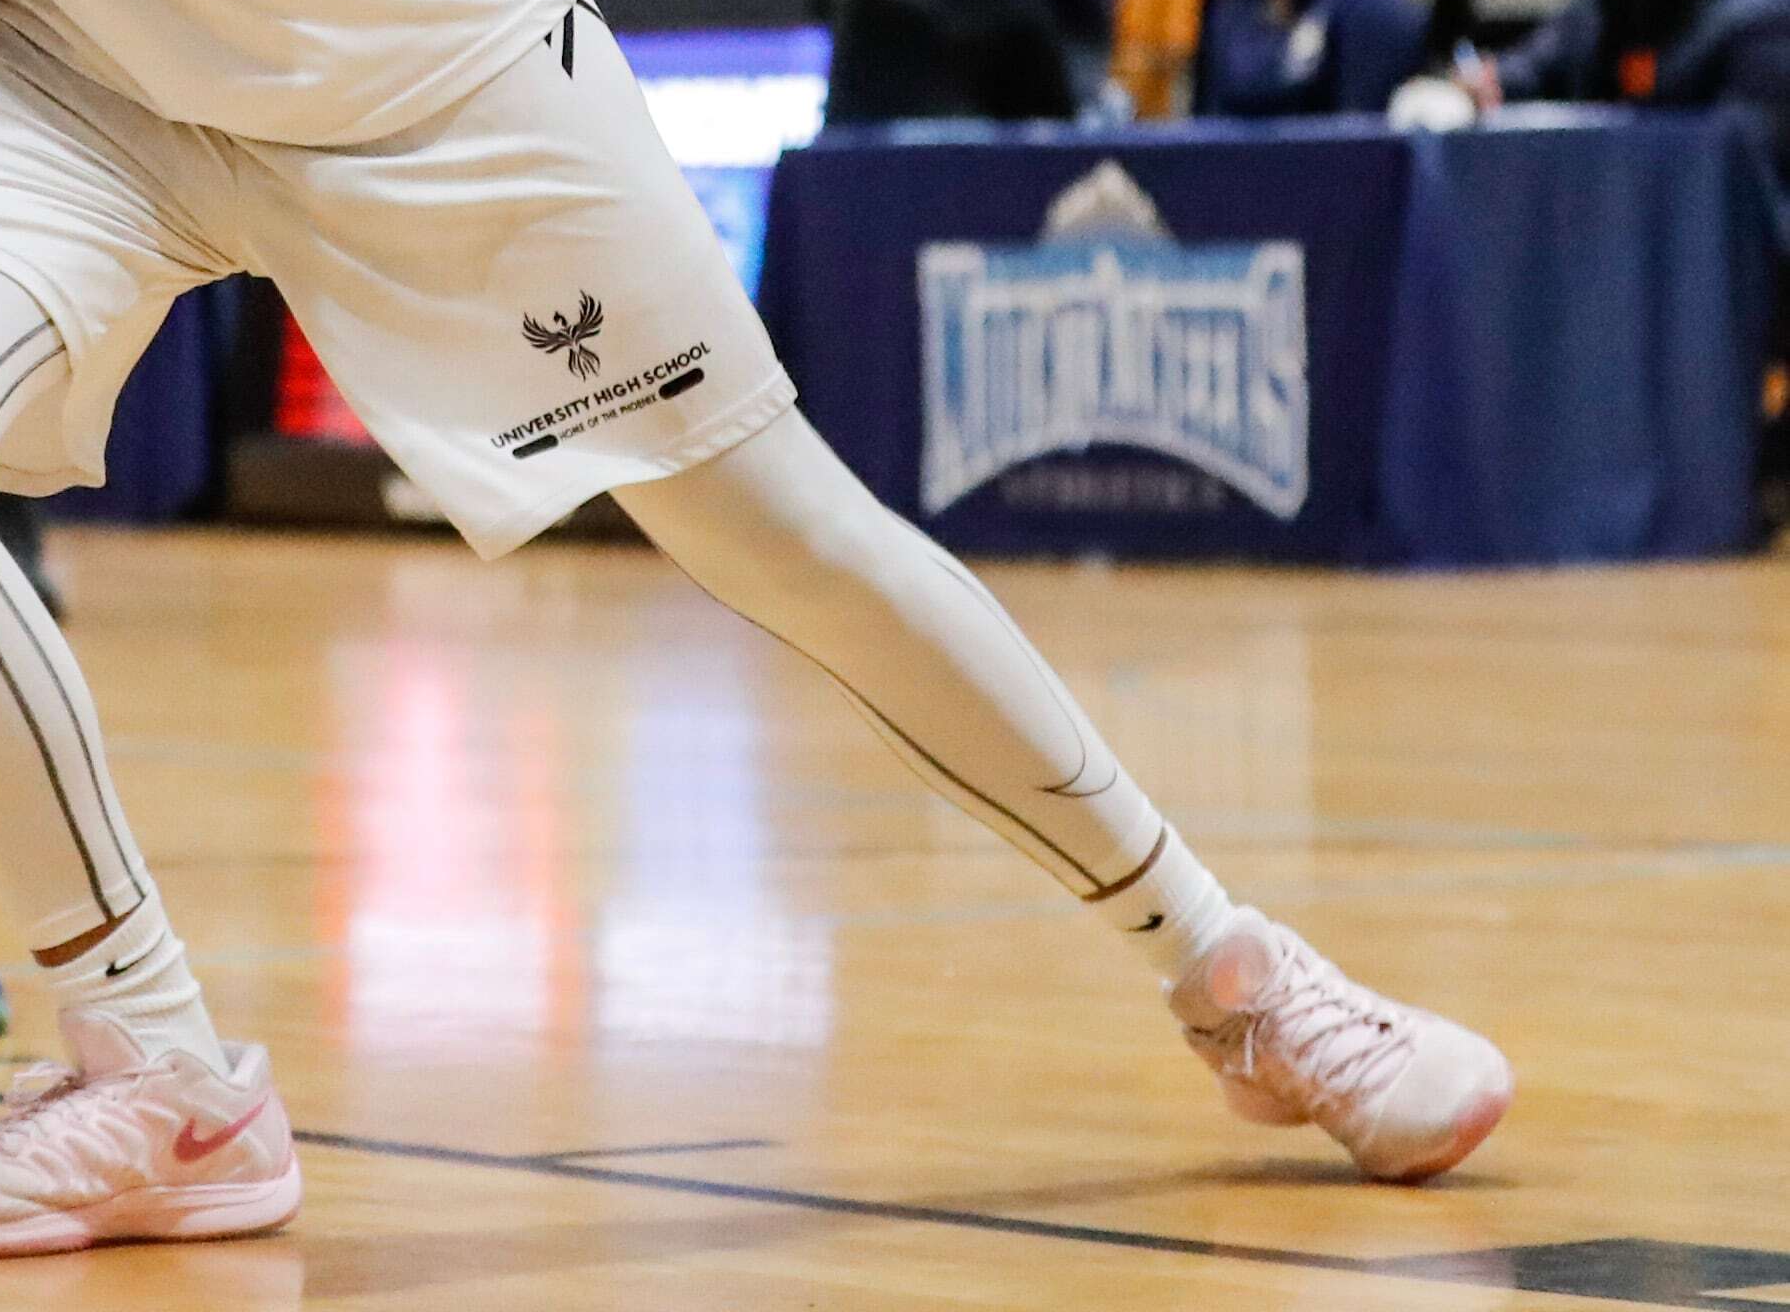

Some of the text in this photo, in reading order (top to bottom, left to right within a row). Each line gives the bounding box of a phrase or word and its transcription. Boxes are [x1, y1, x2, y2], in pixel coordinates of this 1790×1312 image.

[491, 341, 711, 448] UNIVERSITY HIGH SCHOOL
[559, 393, 659, 440] HOME OF THE PHOENIX
